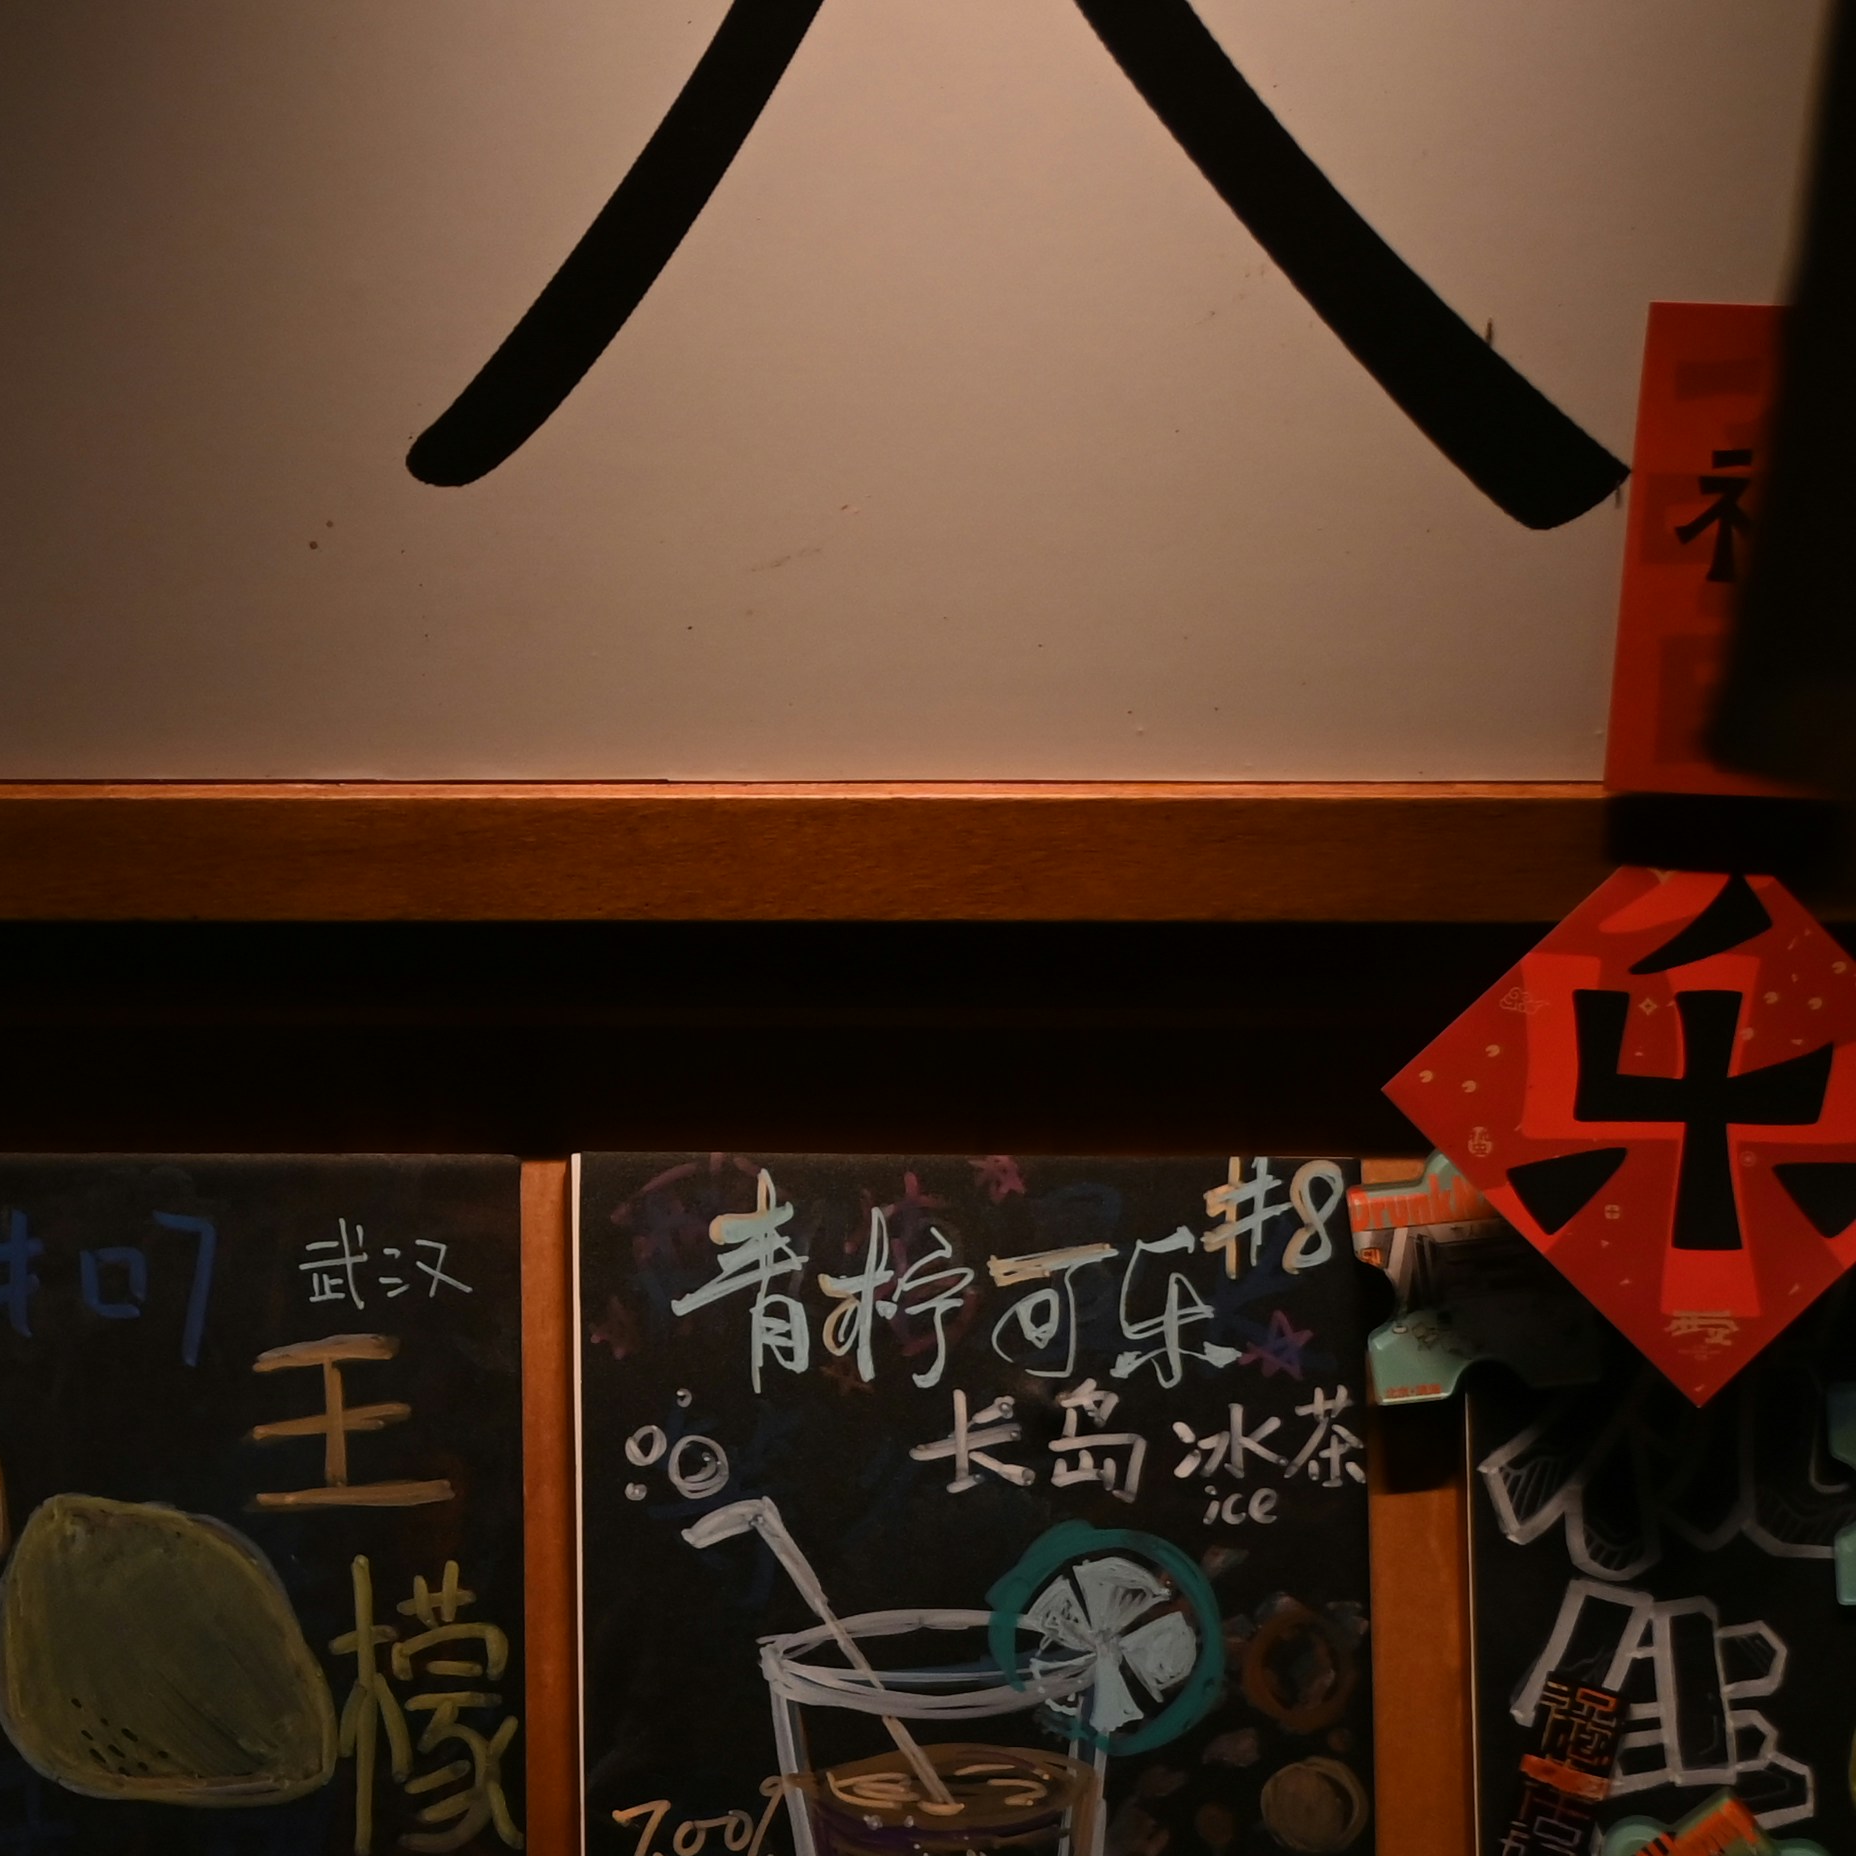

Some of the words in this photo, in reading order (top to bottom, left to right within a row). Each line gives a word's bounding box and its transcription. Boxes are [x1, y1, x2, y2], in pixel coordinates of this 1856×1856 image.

[299, 1217, 473, 1310] 武汉
[1200, 1156, 1347, 1279] #8
[671, 1168, 1244, 1394] 青柠可乐
[1204, 1487, 1279, 1525] ice
